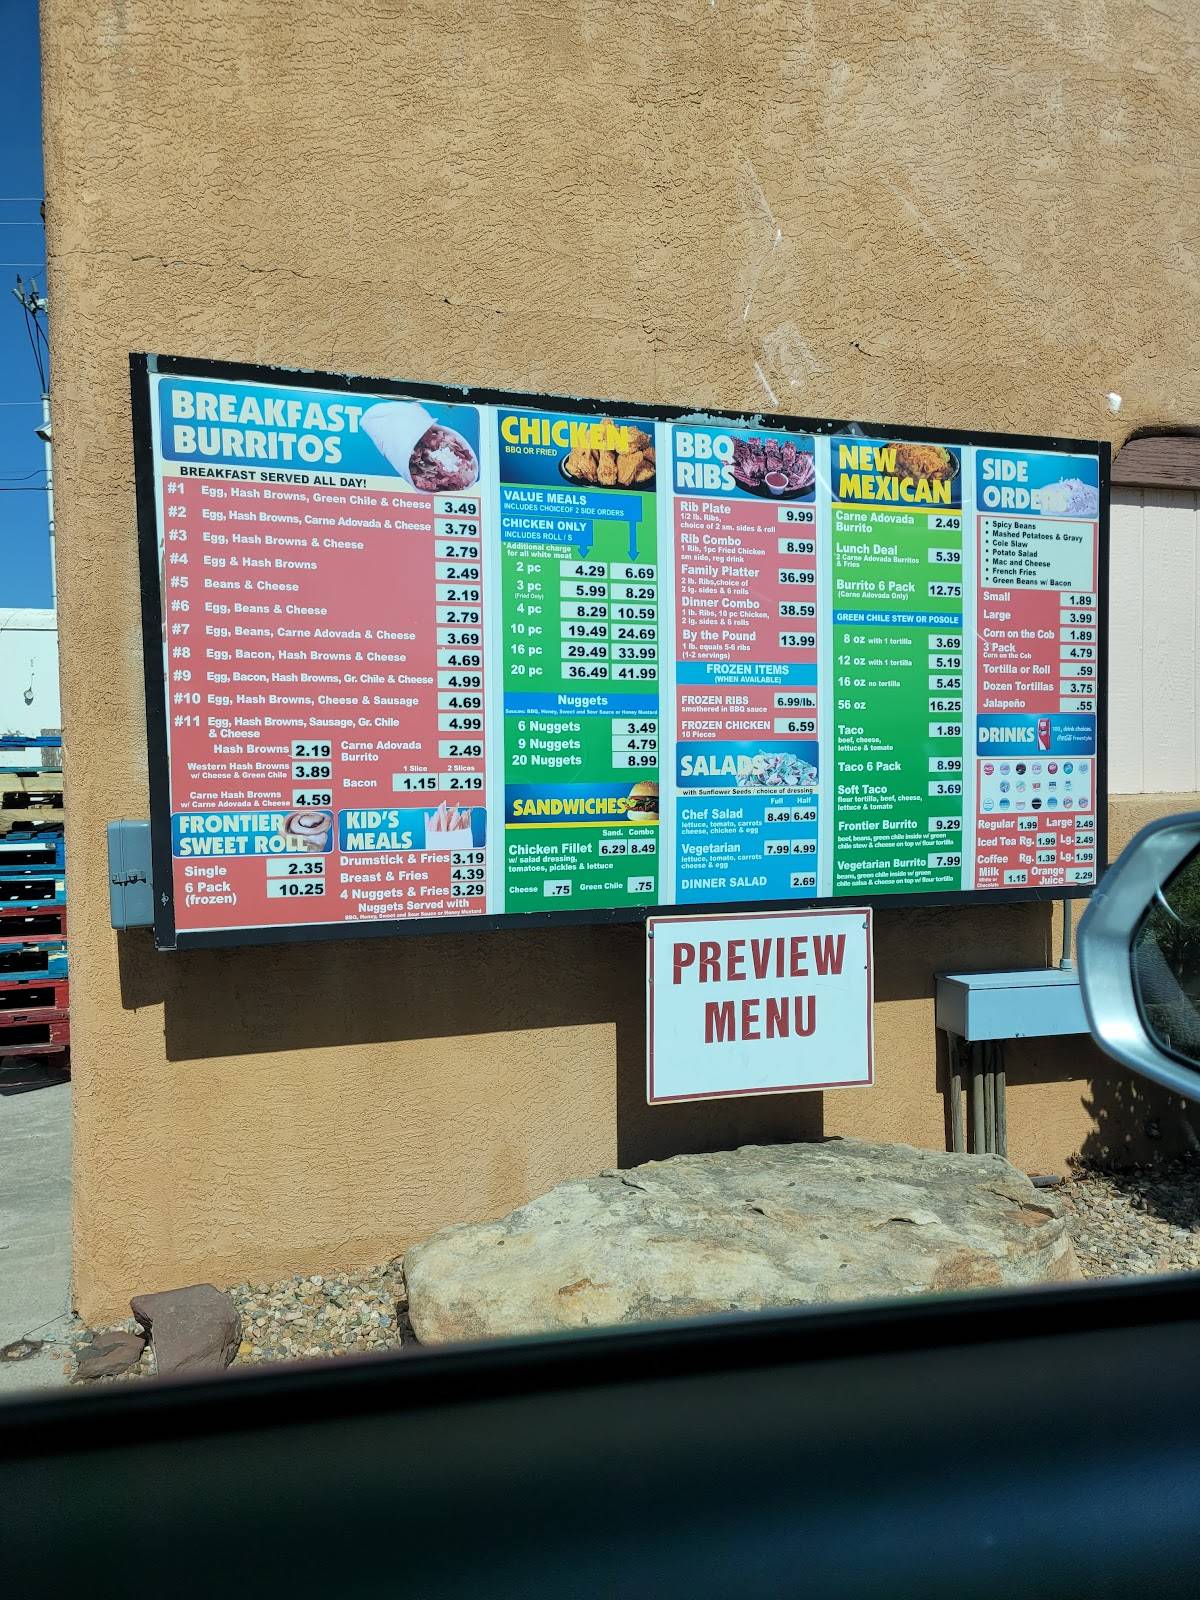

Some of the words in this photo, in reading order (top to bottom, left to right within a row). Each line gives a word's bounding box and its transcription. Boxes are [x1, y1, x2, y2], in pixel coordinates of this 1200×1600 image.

[171, 390, 363, 433] BREAKFAST
[501, 415, 629, 452] CHICKEN
[174, 425, 343, 464] BURRITOS
[505, 445, 521, 453] BBQ
[523, 447, 534, 455] OR
[535, 448, 557, 456] FRIED
[675, 431, 735, 464] BBQ
[839, 445, 897, 473] NEW
[180, 466, 256, 481] BREAKFAST
[260, 472, 310, 484] SERVED
[314, 476, 337, 486] ALL
[340, 478, 367, 489] DAY!
[676, 461, 736, 491] RIBS
[983, 458, 1029, 482] SIDE
[839, 472, 952, 505] MEXICAN
[167, 483, 185, 495] #1
[201, 485, 227, 498] Egg,
[230, 487, 260, 499] Hash
[263, 489, 310, 503] Browns,
[313, 492, 346, 504] Green
[350, 495, 377, 506] Chile
[381, 497, 389, 507] &
[392, 498, 432, 509] Cheese
[444, 501, 476, 514] 3.49
[504, 490, 543, 502] VALUE
[547, 493, 587, 505] MEALS
[983, 485, 1068, 512] ORDE
[680, 502, 698, 513] Rib
[702, 503, 731, 514] Plate
[786, 511, 813, 522] 9.99
[502, 518, 554, 529] CHICKEN
[557, 520, 587, 532] ONLY
[992, 521, 1012, 530] Spicy
[1014, 522, 1037, 530] Beans
[836, 543, 870, 554] Lunch
[873, 544, 898, 555] Deal
[936, 551, 960, 562] 5.39
[169, 553, 188, 565] #4
[203, 556, 225, 568] Egg
[230, 556, 239, 566] &
[242, 557, 272, 568] Hash
[275, 559, 317, 570] Browns
[447, 567, 479, 580] 2.49
[516, 562, 524, 572] 2
[527, 564, 541, 574] pc
[575, 565, 606, 577] 4.29
[625, 567, 654, 579] 6.69
[681, 564, 719, 577] Family
[721, 566, 760, 577] Platter
[780, 572, 814, 583] 36.99
[170, 577, 189, 588] #5
[204, 579, 240, 590] Beans
[244, 580, 253, 590] &
[256, 581, 299, 592] Cheese
[447, 589, 479, 602] 2.19
[983, 592, 1010, 601] Small
[1070, 596, 1092, 605] 1.89
[837, 613, 865, 622] GREEN
[866, 614, 890, 622] CHILE
[892, 615, 915, 623] STEW
[916, 615, 927, 623] OR
[929, 616, 959, 624] POSOLE
[511, 624, 524, 633] 10
[528, 626, 542, 636] pc
[568, 625, 607, 637] 19.49
[618, 627, 656, 639] 24.69
[706, 663, 752, 675] FROZEN
[755, 665, 789, 675] ITEMS
[740, 676, 782, 684] AVAILABLE)
[983, 682, 1013, 691] Dozen
[1015, 682, 1054, 691] Tortillas
[1070, 683, 1093, 693] 3.75
[173, 693, 201, 705] #10
[207, 695, 233, 707] Egg,
[236, 695, 266, 705] Hash
[269, 695, 315, 707] Browns,
[318, 695, 359, 706] Cheese
[362, 696, 370, 706] &
[373, 696, 419, 707] Sausage
[449, 697, 481, 709] 4.69
[558, 695, 608, 707] Nuggets
[681, 705, 719, 713] smothered
[720, 705, 728, 713] in
[729, 705, 745, 713] BBQ
[518, 721, 526, 731] 6
[530, 721, 581, 733] Nuggets
[627, 723, 656, 733] 3.49
[838, 725, 864, 735] Taco
[937, 726, 961, 735] 1.89
[979, 727, 1035, 743] DRINKS
[213, 744, 244, 754] Hash
[247, 744, 289, 754] Browns
[295, 745, 330, 758] 2.19
[838, 762, 864, 772] Taco
[867, 761, 873, 771] 6
[876, 761, 902, 771] Pack
[937, 760, 961, 770] 8.99
[343, 778, 377, 788] Bacon
[403, 778, 437, 790] 1.15
[450, 778, 483, 789] 2.19
[513, 797, 627, 816] SANDWICHES
[346, 811, 400, 829] KID'S
[682, 809, 708, 819] Chef
[712, 808, 743, 819] Salad
[767, 813, 790, 822] 8.49
[794, 812, 816, 820] 6.49
[179, 814, 285, 834] FRONTIER
[978, 819, 1015, 830] Regular
[1019, 821, 1037, 830] 1.99
[1046, 817, 1072, 828] Large
[1076, 820, 1094, 828] 2.49
[179, 836, 249, 855] SWEET
[254, 835, 309, 854] ROLL
[346, 831, 413, 851] MEALS
[509, 844, 558, 854] Chicken
[562, 843, 592, 853] Fillet
[601, 845, 626, 854] 6.29
[631, 844, 655, 853] 8.49
[339, 855, 403, 866] Drumstick
[407, 854, 416, 864] &
[420, 853, 450, 863] Fries
[452, 852, 484, 864] 3.19
[184, 865, 227, 878] Single
[288, 863, 323, 875] 2.35
[340, 872, 380, 883] Breast
[384, 872, 394, 882] &
[398, 870, 429, 881] Fries
[452, 869, 484, 881] 4.39
[185, 883, 193, 893] 6
[197, 881, 231, 893] Pack
[279, 883, 324, 896] 10.25
[552, 885, 570, 895] .75
[604, 882, 623, 890] Chile
[635, 882, 652, 891] .75
[681, 878, 726, 889] DINNER
[729, 876, 767, 887] SALAD
[793, 877, 815, 886] 2.69
[185, 894, 237, 906] (frozen)
[672, 934, 846, 985] PREVIEW
[704, 995, 816, 1044] MENU
